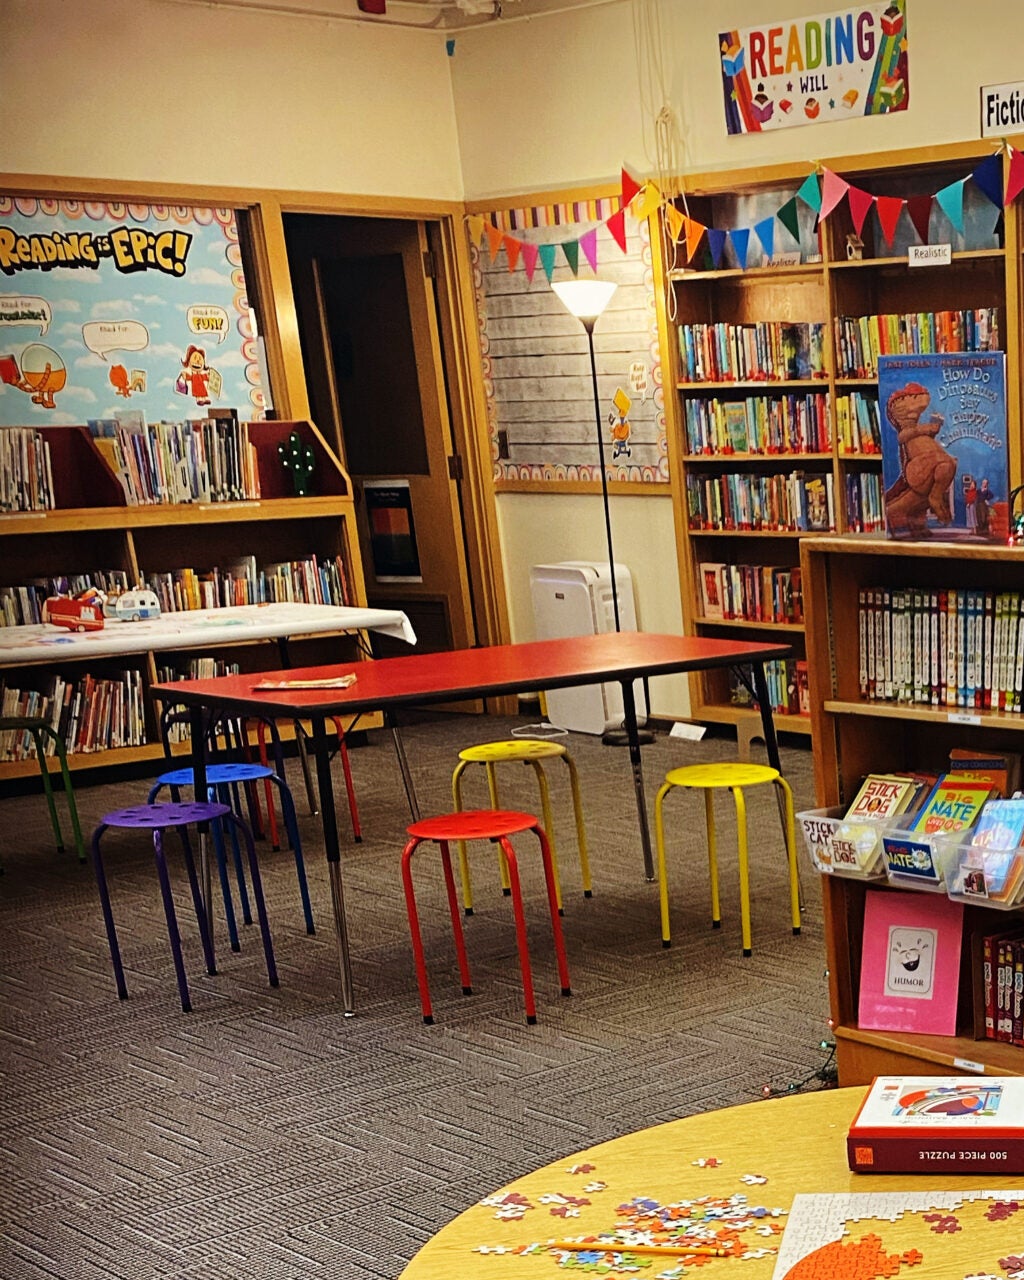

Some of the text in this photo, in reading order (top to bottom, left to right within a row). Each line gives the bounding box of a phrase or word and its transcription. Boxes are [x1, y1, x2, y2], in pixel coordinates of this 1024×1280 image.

[749, 11, 875, 79] READING
[800, 74, 828, 94] WILL
[914, 246, 947, 259] Realistic
[192, 316, 224, 330] FUN!
[942, 367, 990, 384] How Do
[938, 383, 998, 403] Dinosaurs
[865, 782, 902, 799] STICK
[855, 796, 892, 814] DOG
[930, 801, 976, 821] NATE
[803, 820, 834, 835] STICK
[809, 833, 829, 847] CAT
[832, 839, 852, 851] STICK
[834, 850, 856, 864] DOG
[887, 853, 914, 869] NATE
[894, 976, 924, 987] HUMOR
[919, 1151, 1008, 1160] 500 PIECE PUZZLE
